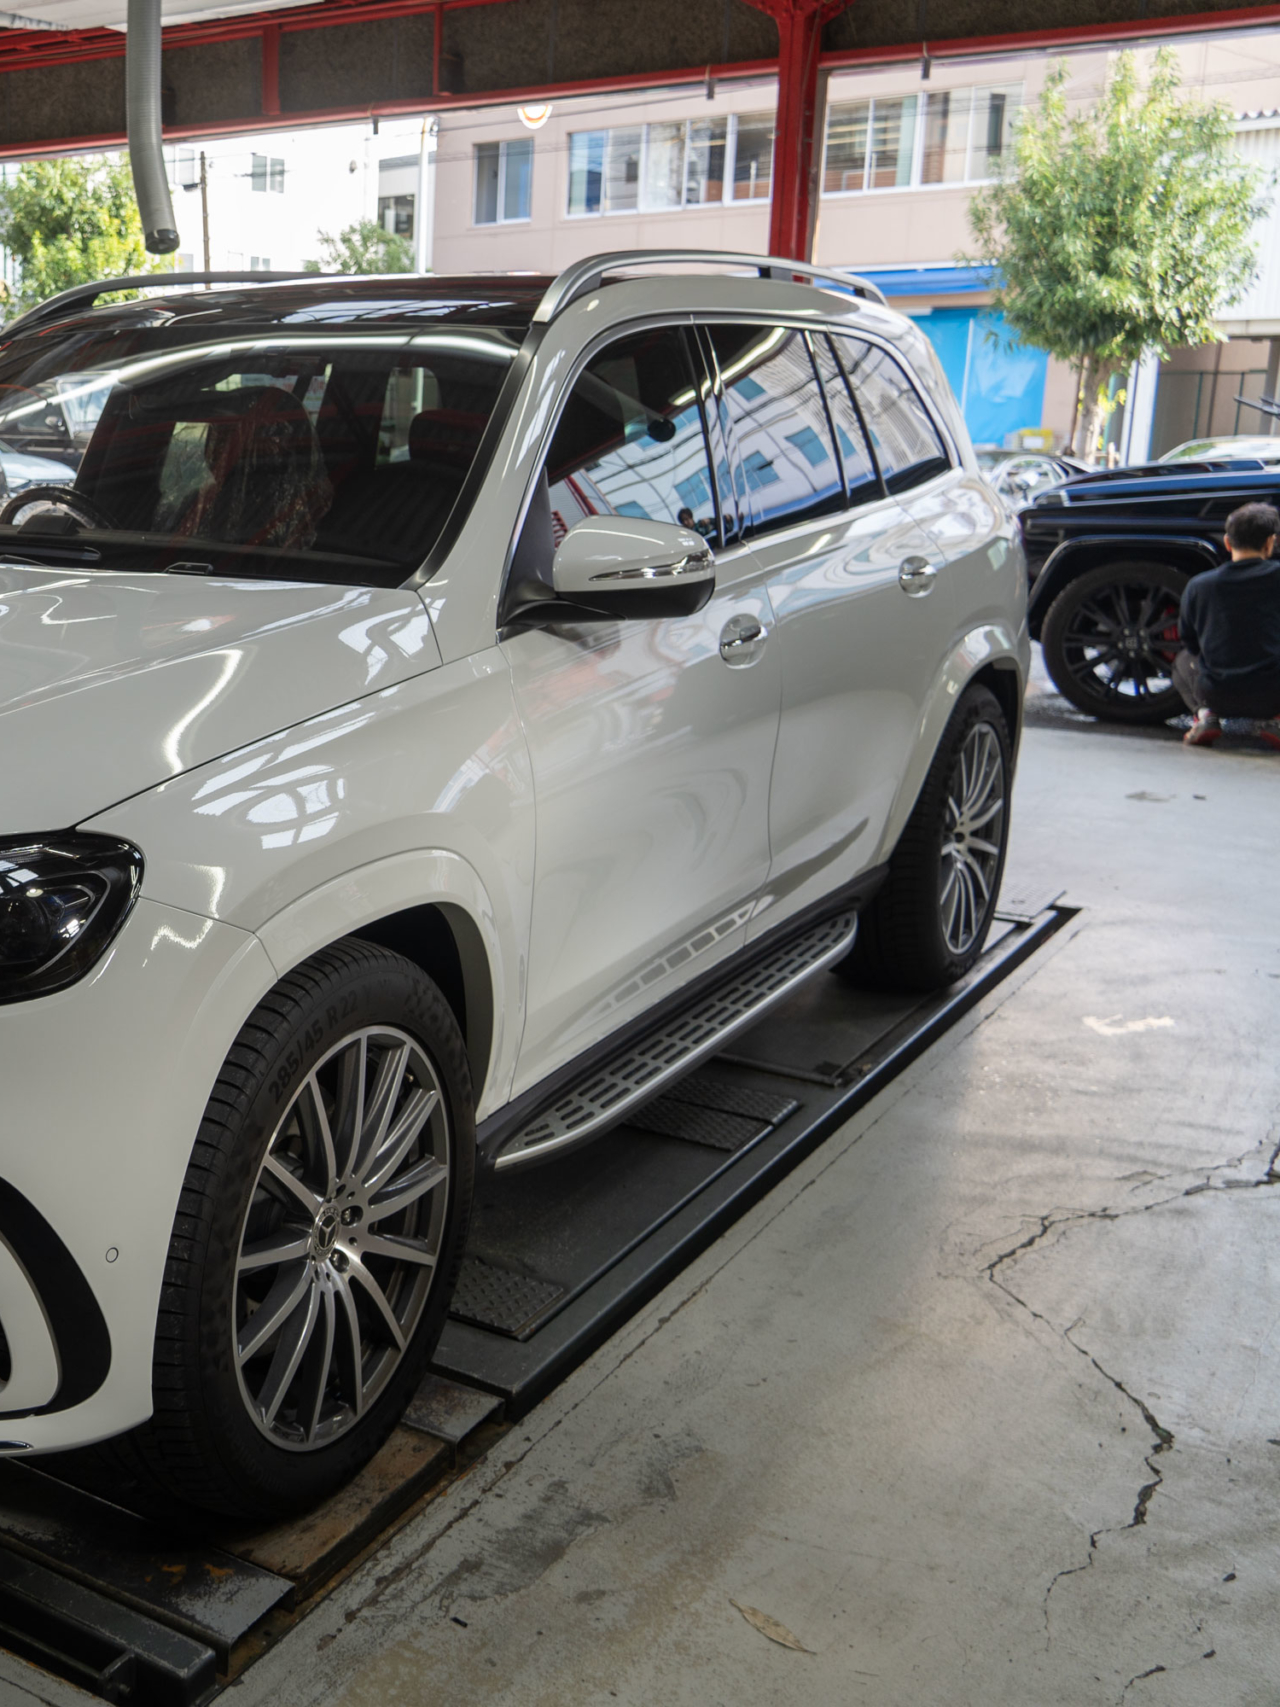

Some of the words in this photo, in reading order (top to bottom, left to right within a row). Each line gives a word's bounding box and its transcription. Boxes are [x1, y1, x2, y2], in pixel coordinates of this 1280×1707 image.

[267, 1018, 325, 1104] 285/45
[325, 1004, 340, 1030] R
[339, 988, 359, 1019] 22
